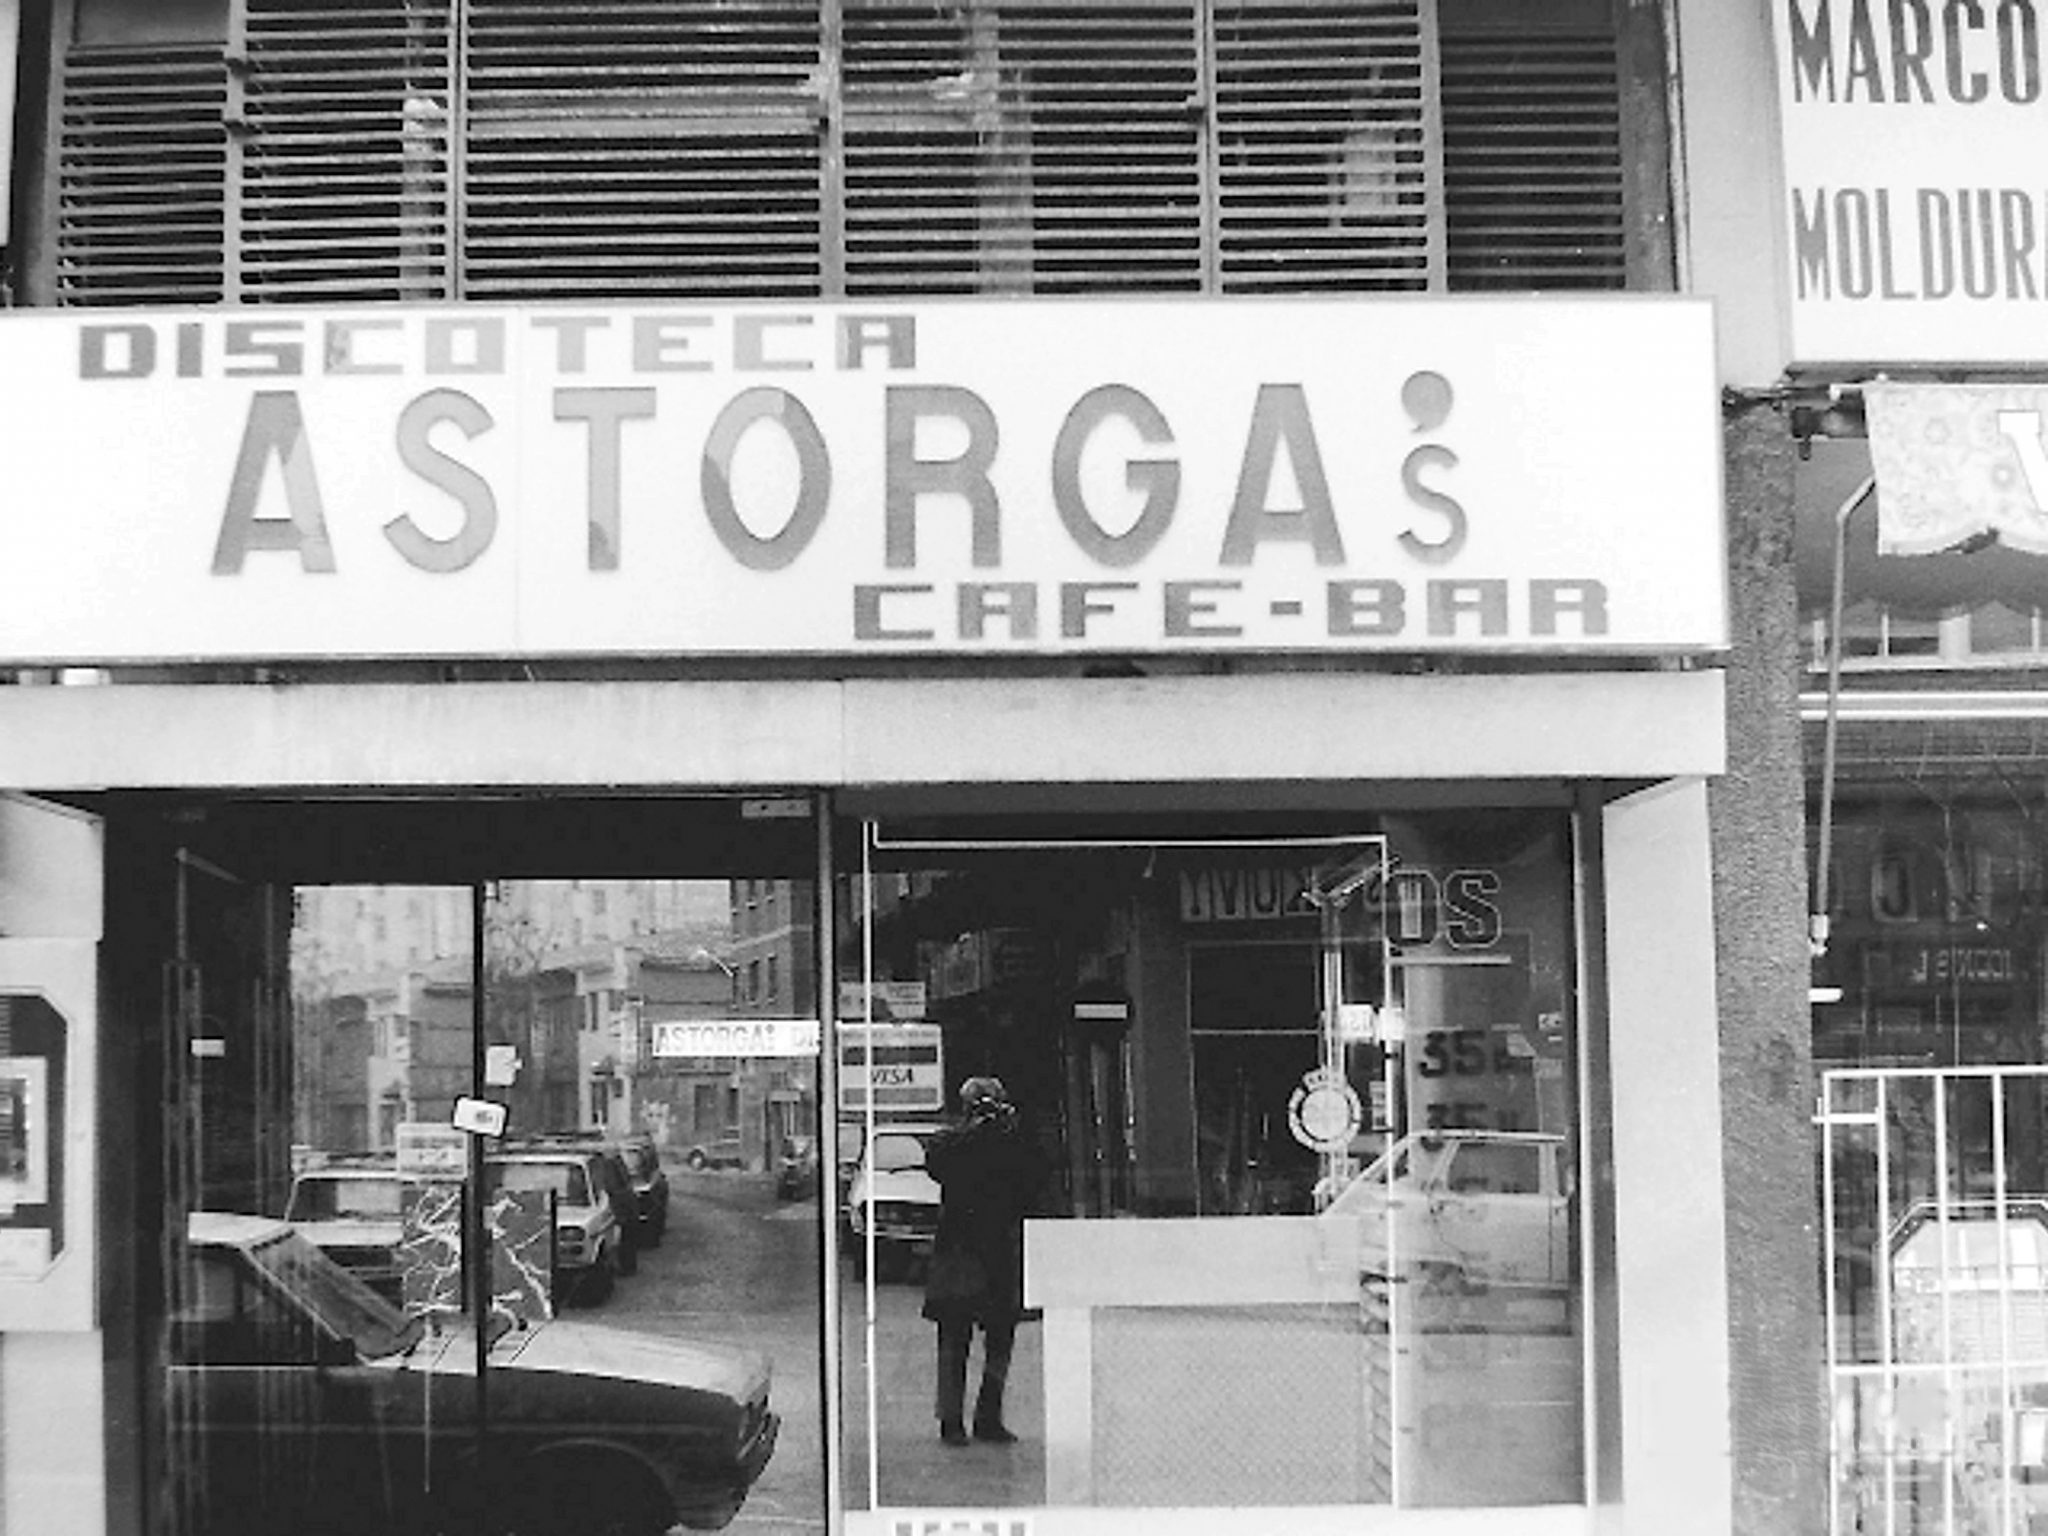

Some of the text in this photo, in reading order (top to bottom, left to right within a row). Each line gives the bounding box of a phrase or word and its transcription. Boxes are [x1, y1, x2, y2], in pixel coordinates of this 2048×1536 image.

[1792, 187, 2048, 300] MOLDUR
[78, 314, 917, 380] DISCOTECA
[854, 579, 1609, 642] CAFE-BAR
[870, 1067, 915, 1086] VISA
